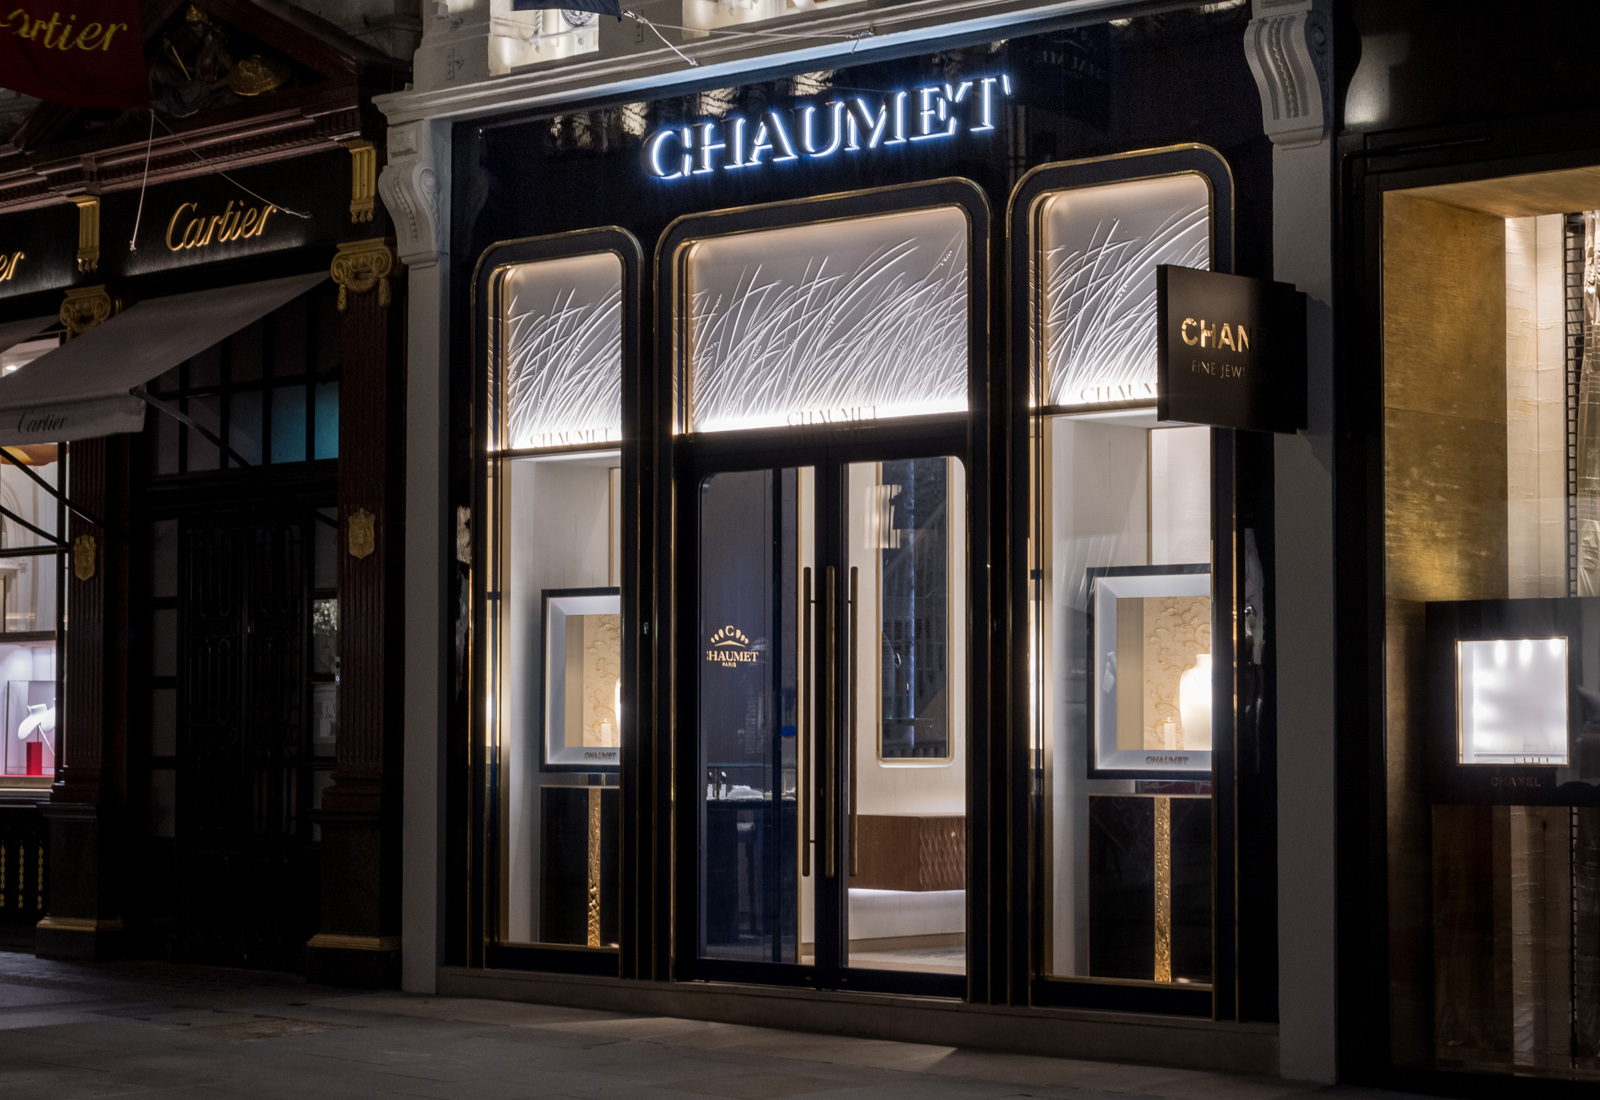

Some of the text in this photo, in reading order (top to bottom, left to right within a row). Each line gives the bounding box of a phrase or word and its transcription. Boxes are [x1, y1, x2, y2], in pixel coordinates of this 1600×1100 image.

[0, 8, 128, 51] artier
[641, 74, 1011, 181] CHAUMET
[166, 201, 277, 251] Cartier
[1181, 317, 1267, 353] CHAN
[1191, 360, 1216, 376] FINE
[17, 409, 68, 433] Cartier
[706, 650, 760, 662] HAUMET
[1145, 755, 1190, 765] CHAUMET
[1491, 776, 1542, 788] CHANEL
